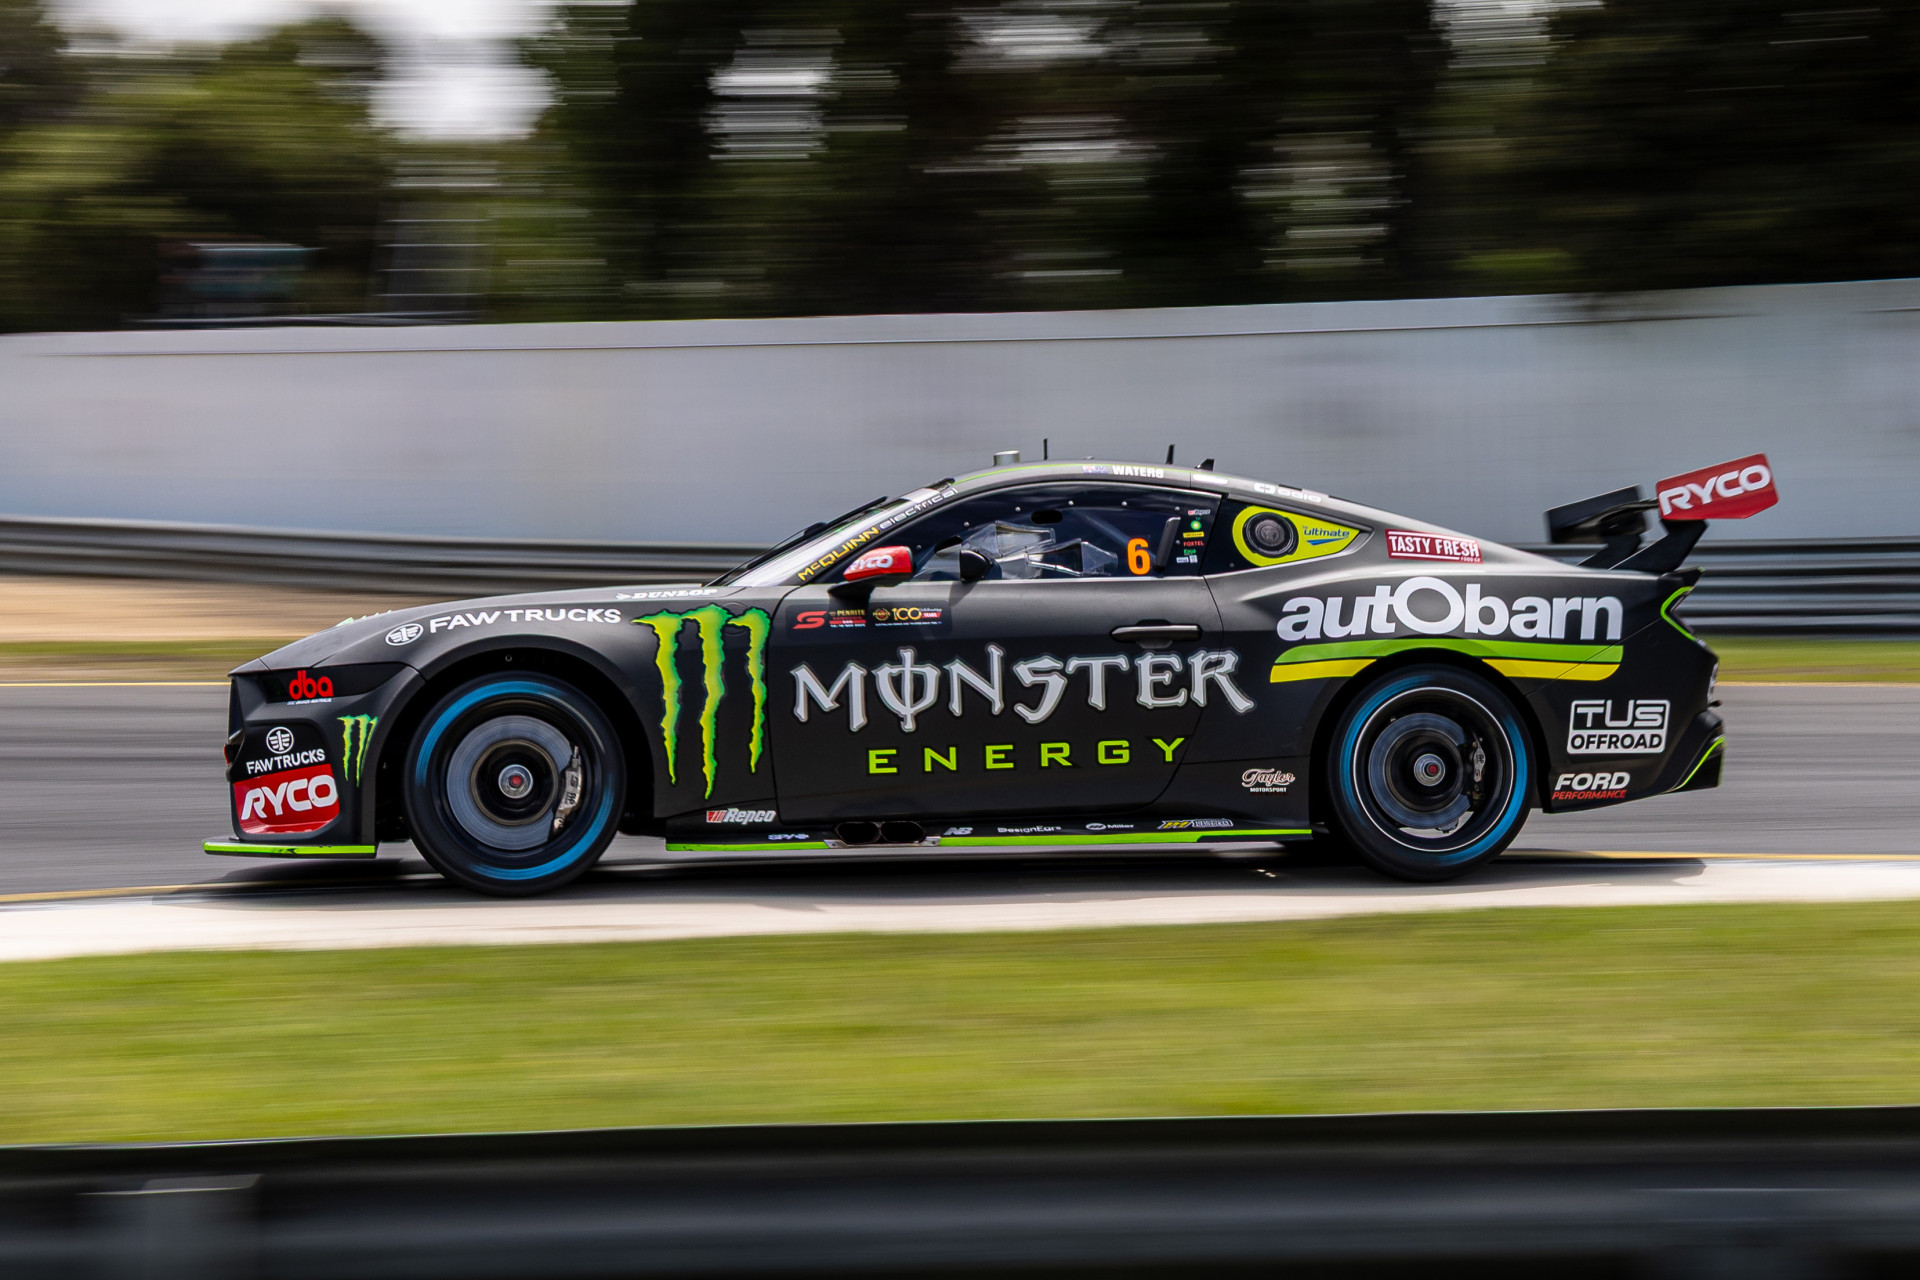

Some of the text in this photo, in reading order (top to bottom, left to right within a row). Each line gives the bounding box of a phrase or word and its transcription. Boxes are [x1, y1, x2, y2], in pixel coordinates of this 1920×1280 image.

[1112, 465, 1164, 479] WATERS
[1659, 464, 1771, 516] RYCO
[879, 487, 958, 530] electrical
[1304, 527, 1350, 538] ultimate
[1127, 537, 1151, 575] 6
[1388, 536, 1480, 557] TASTY FRESH
[631, 588, 718, 599] DUNLOP
[429, 608, 621, 633] FAW TRUCKS
[836, 608, 866, 616] PENRITE
[891, 607, 922, 621] 100
[288, 670, 334, 700] dba
[790, 643, 1256, 733] MONSTER
[1576, 699, 1664, 728] TUS
[1570, 733, 1663, 750] OFFROAD
[246, 748, 326, 775] FAW TRUCKS
[868, 737, 1185, 775] ENERGY
[1241, 768, 1296, 787] Taylor
[1554, 771, 1631, 791] FORD
[240, 774, 339, 821] RYCO
[1551, 790, 1628, 800] PERFORMANCE
[723, 808, 777, 825] Repco
